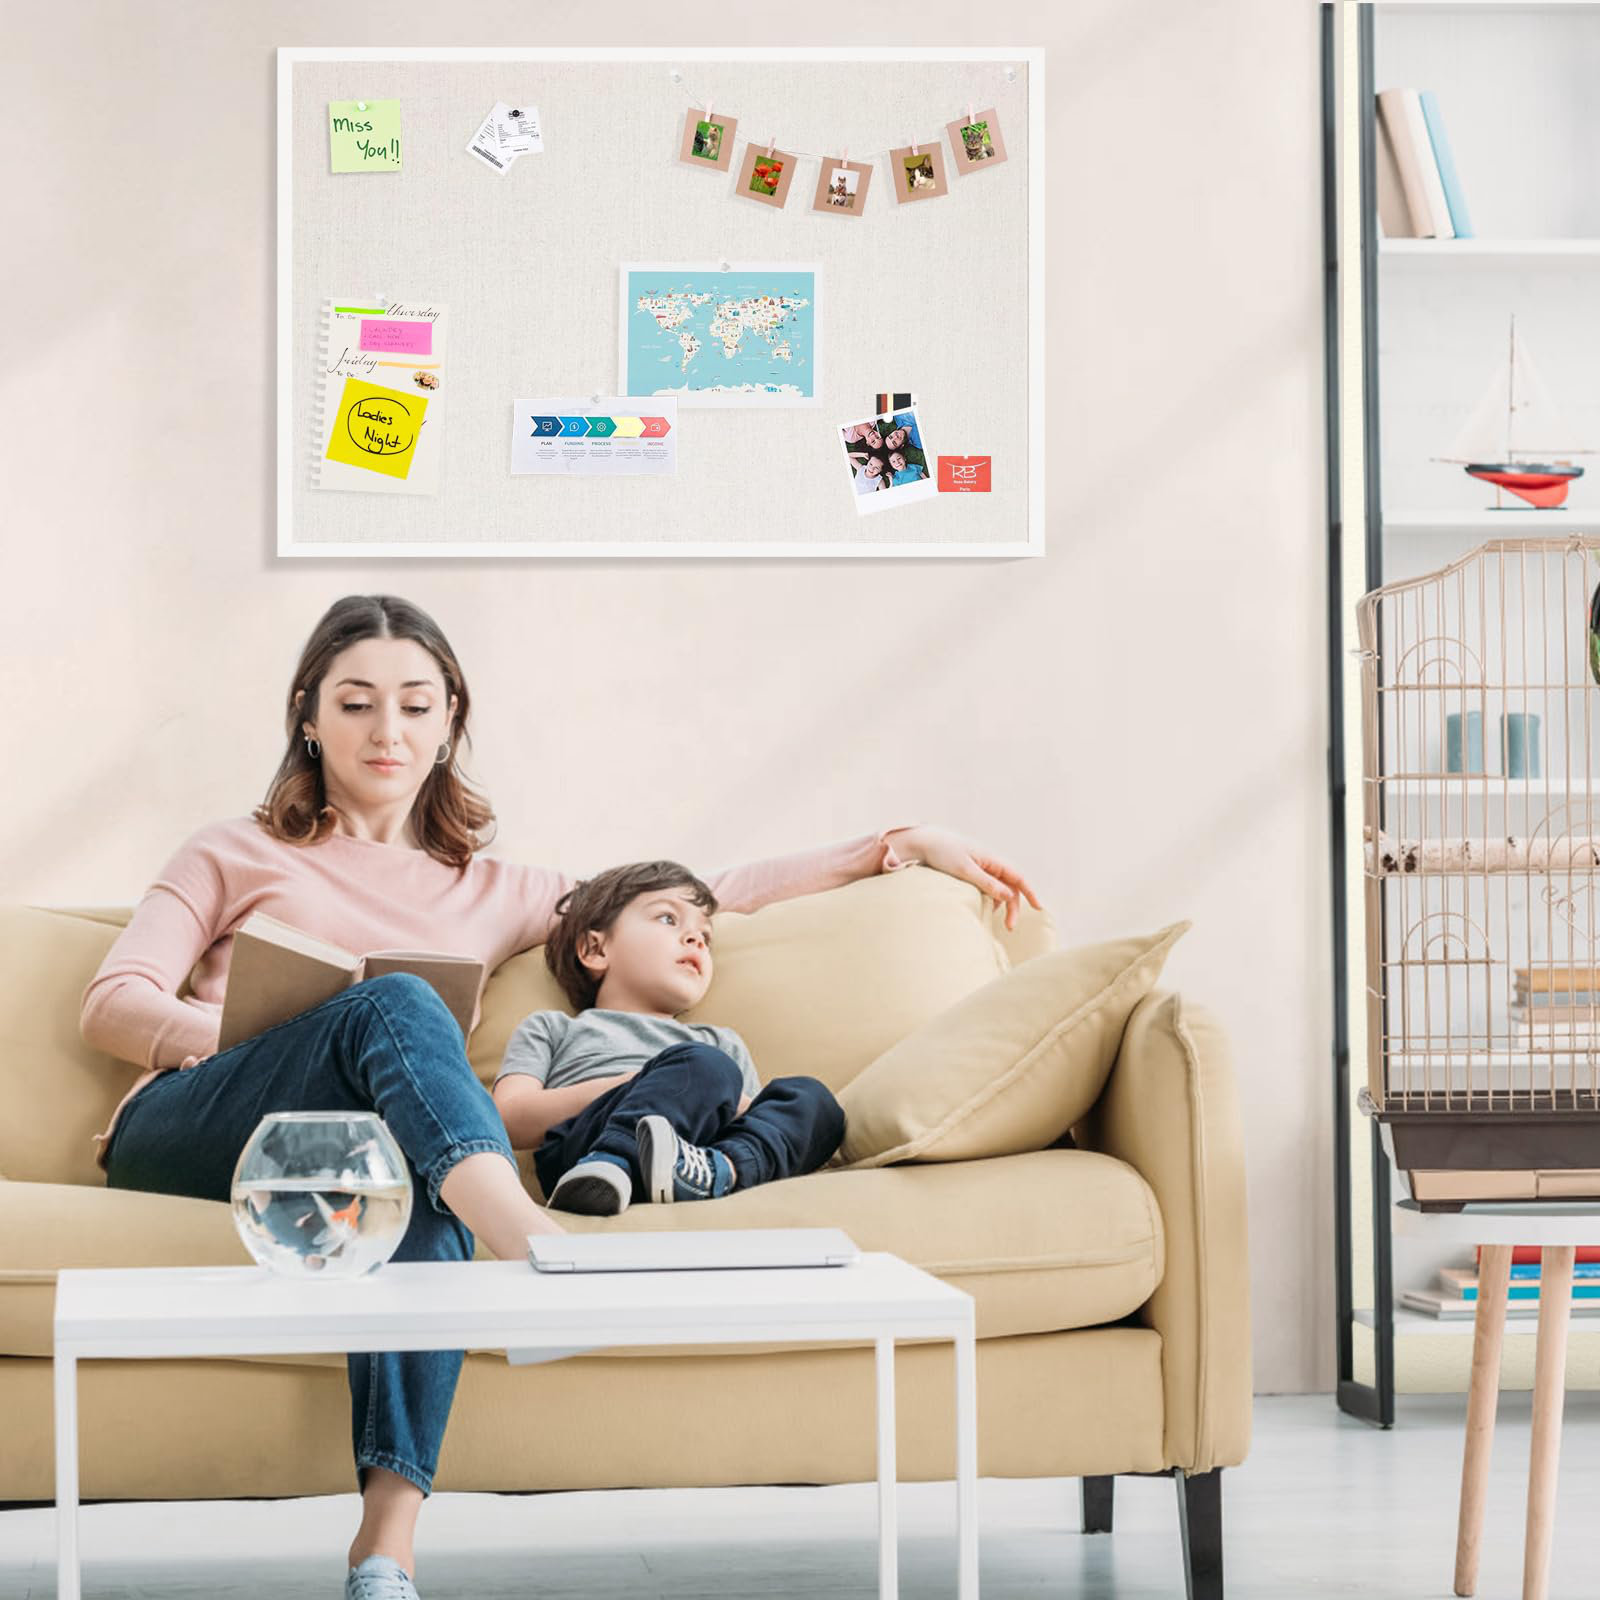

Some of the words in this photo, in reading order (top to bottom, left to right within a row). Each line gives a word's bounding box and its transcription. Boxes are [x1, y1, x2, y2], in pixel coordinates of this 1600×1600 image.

[333, 117, 373, 133] Miss
[356, 138, 400, 164] You!!
[357, 402, 393, 425] Ladies
[364, 426, 401, 454] Night
